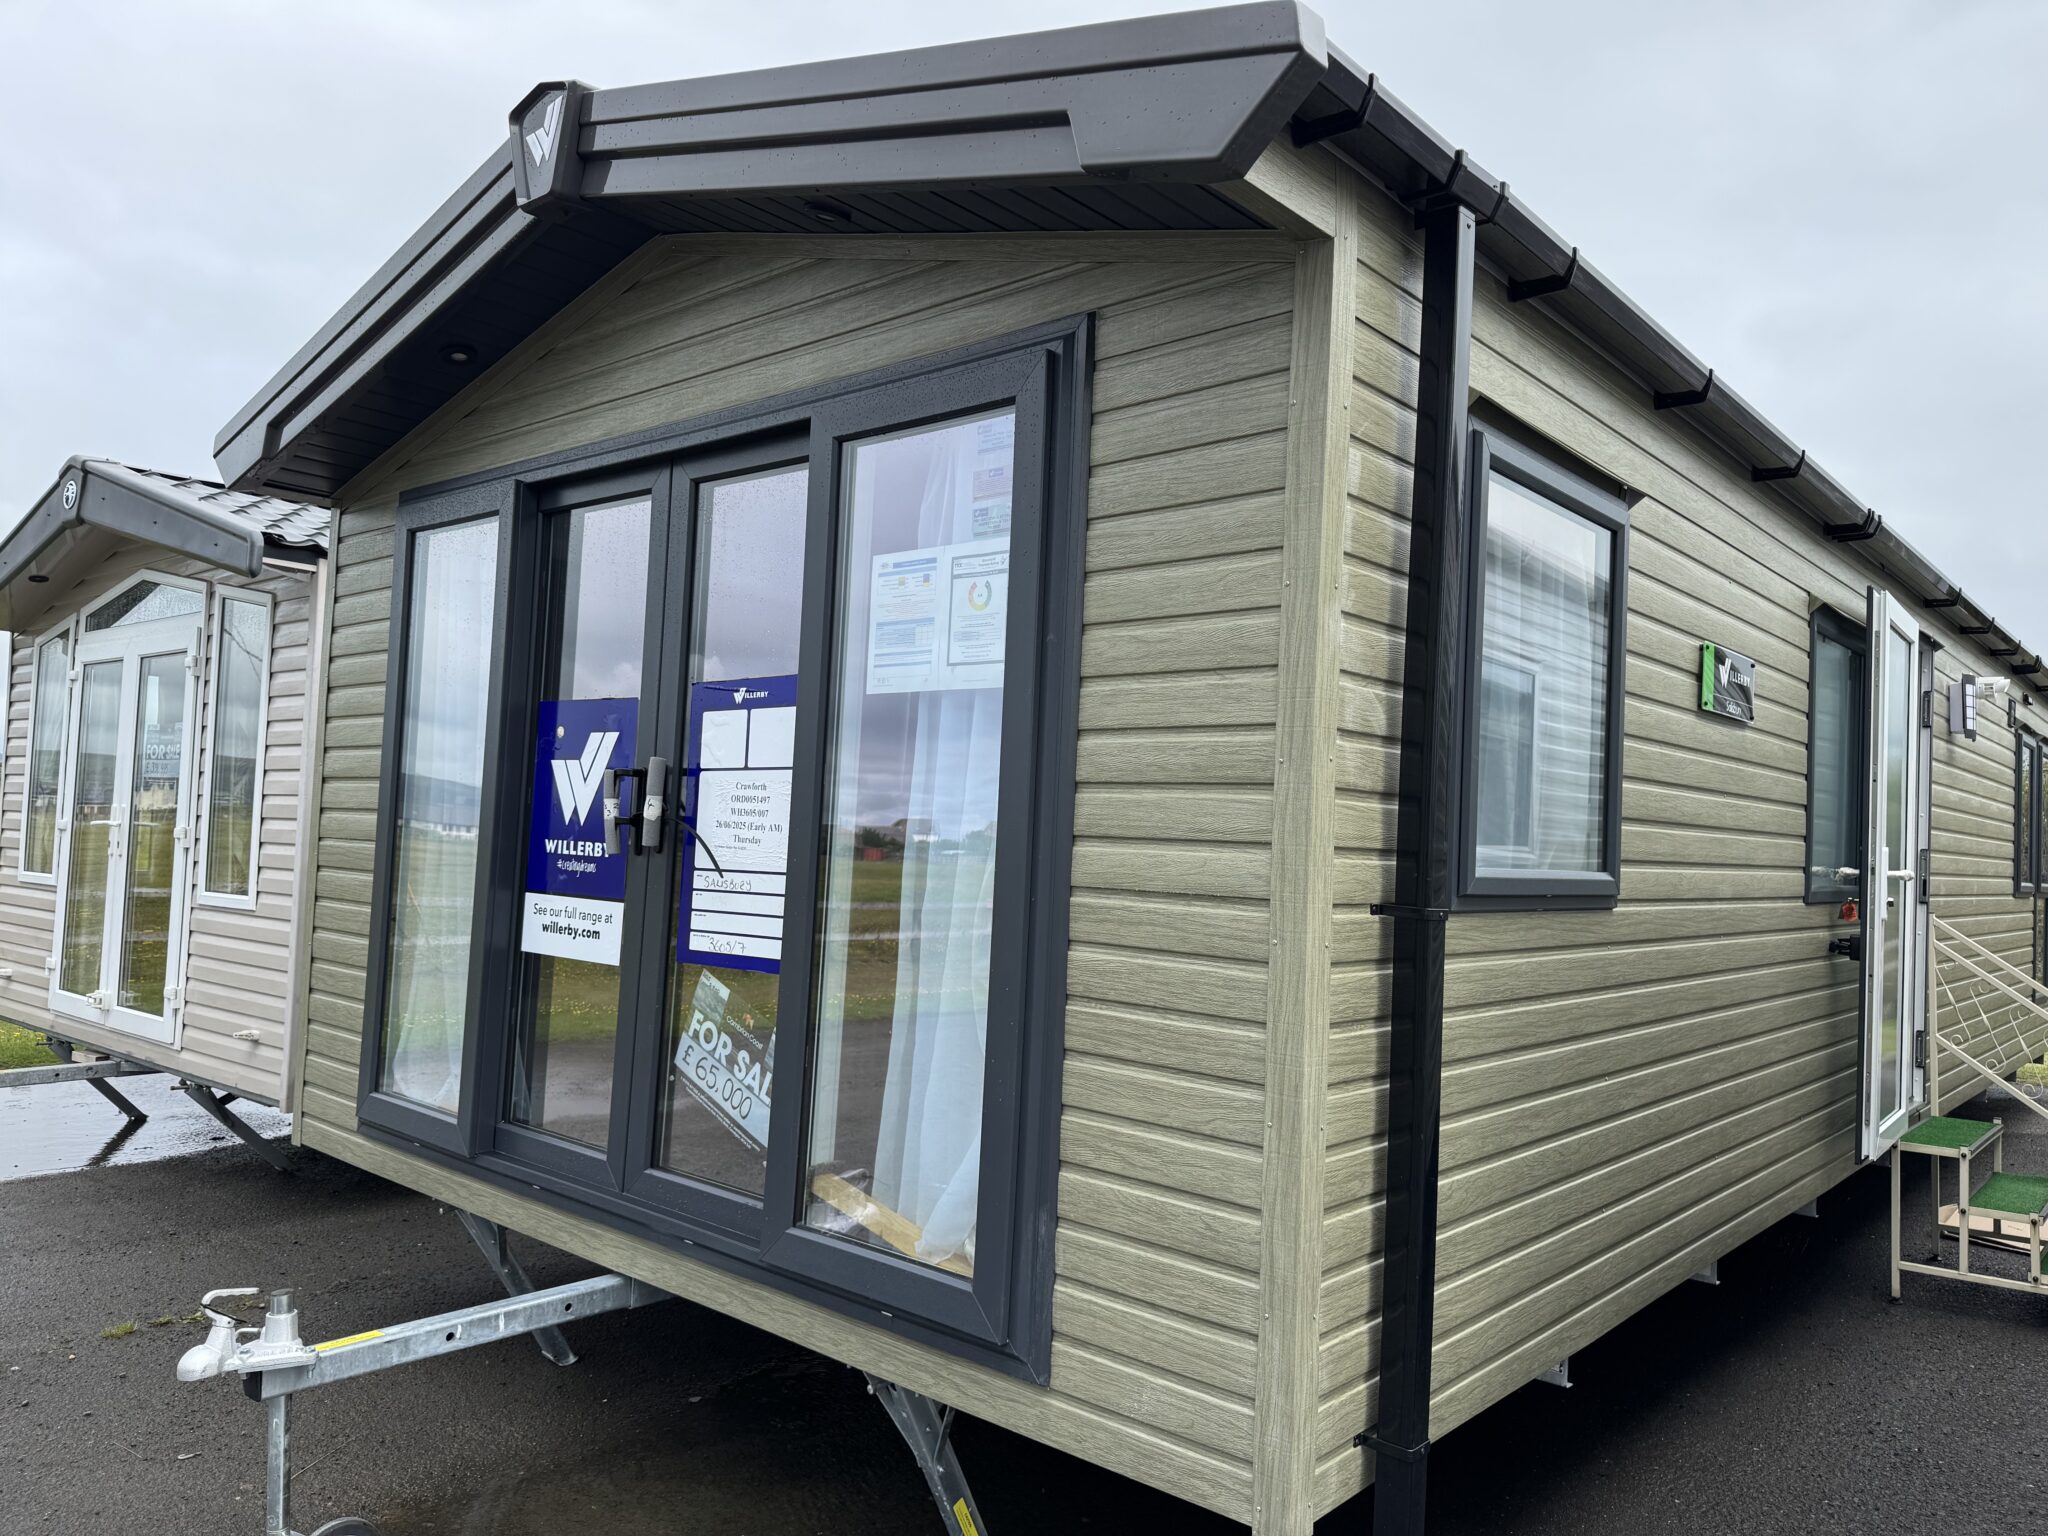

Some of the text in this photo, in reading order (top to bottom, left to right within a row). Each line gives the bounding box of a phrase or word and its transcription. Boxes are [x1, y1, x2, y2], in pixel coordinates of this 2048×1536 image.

[733, 687, 769, 704] WILLERBY
[146, 743, 166, 760] FOR
[733, 834, 762, 847] Thursday
[533, 902, 613, 926] See our full range at
[542, 920, 601, 940] willerby.com
[687, 1009, 773, 1106] FOR SAL
